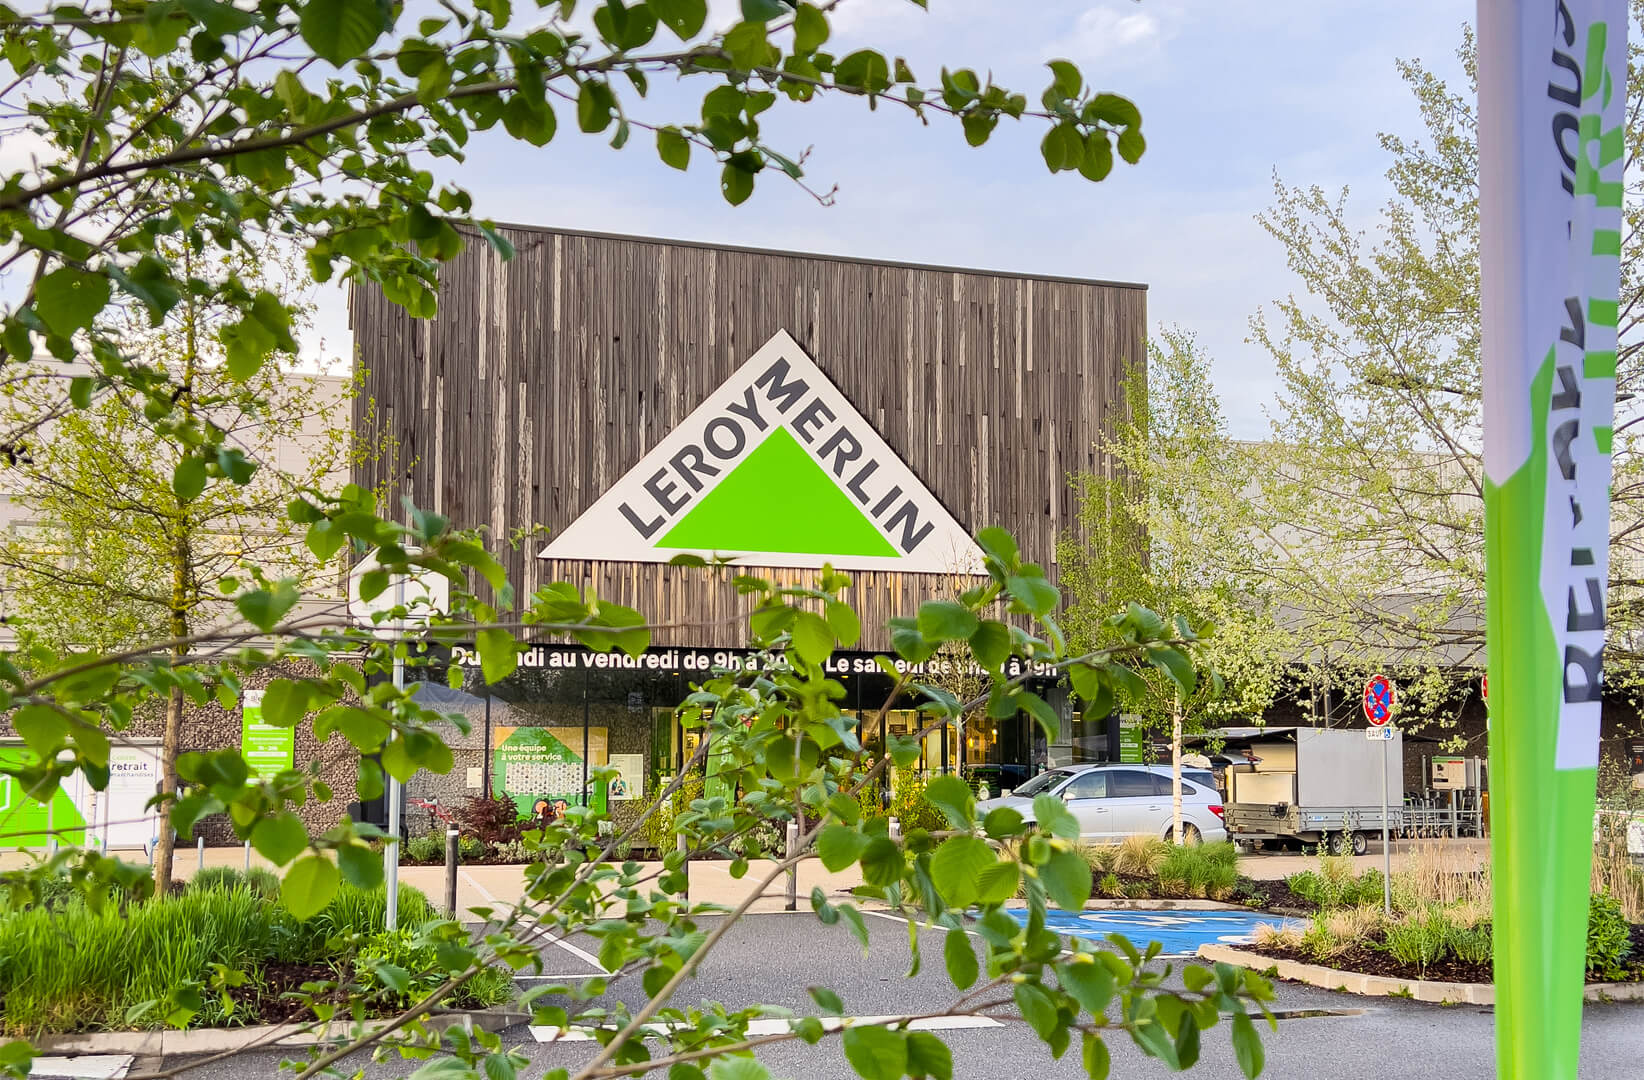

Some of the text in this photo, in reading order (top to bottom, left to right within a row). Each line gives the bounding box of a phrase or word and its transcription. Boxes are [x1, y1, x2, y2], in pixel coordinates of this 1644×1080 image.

[617, 356, 935, 554] LEROY MERLIN
[549, 651, 576, 667] au
[581, 649, 679, 669] vendredi
[683, 650, 710, 669] de
[713, 650, 741, 670] 9h
[762, 652, 795, 672] 20
[825, 655, 850, 673] Le
[1008, 657, 1021, 676] à
[501, 743, 547, 753] Une équipe
[501, 752, 562, 761] à votre service
[111, 761, 148, 771] retrait
